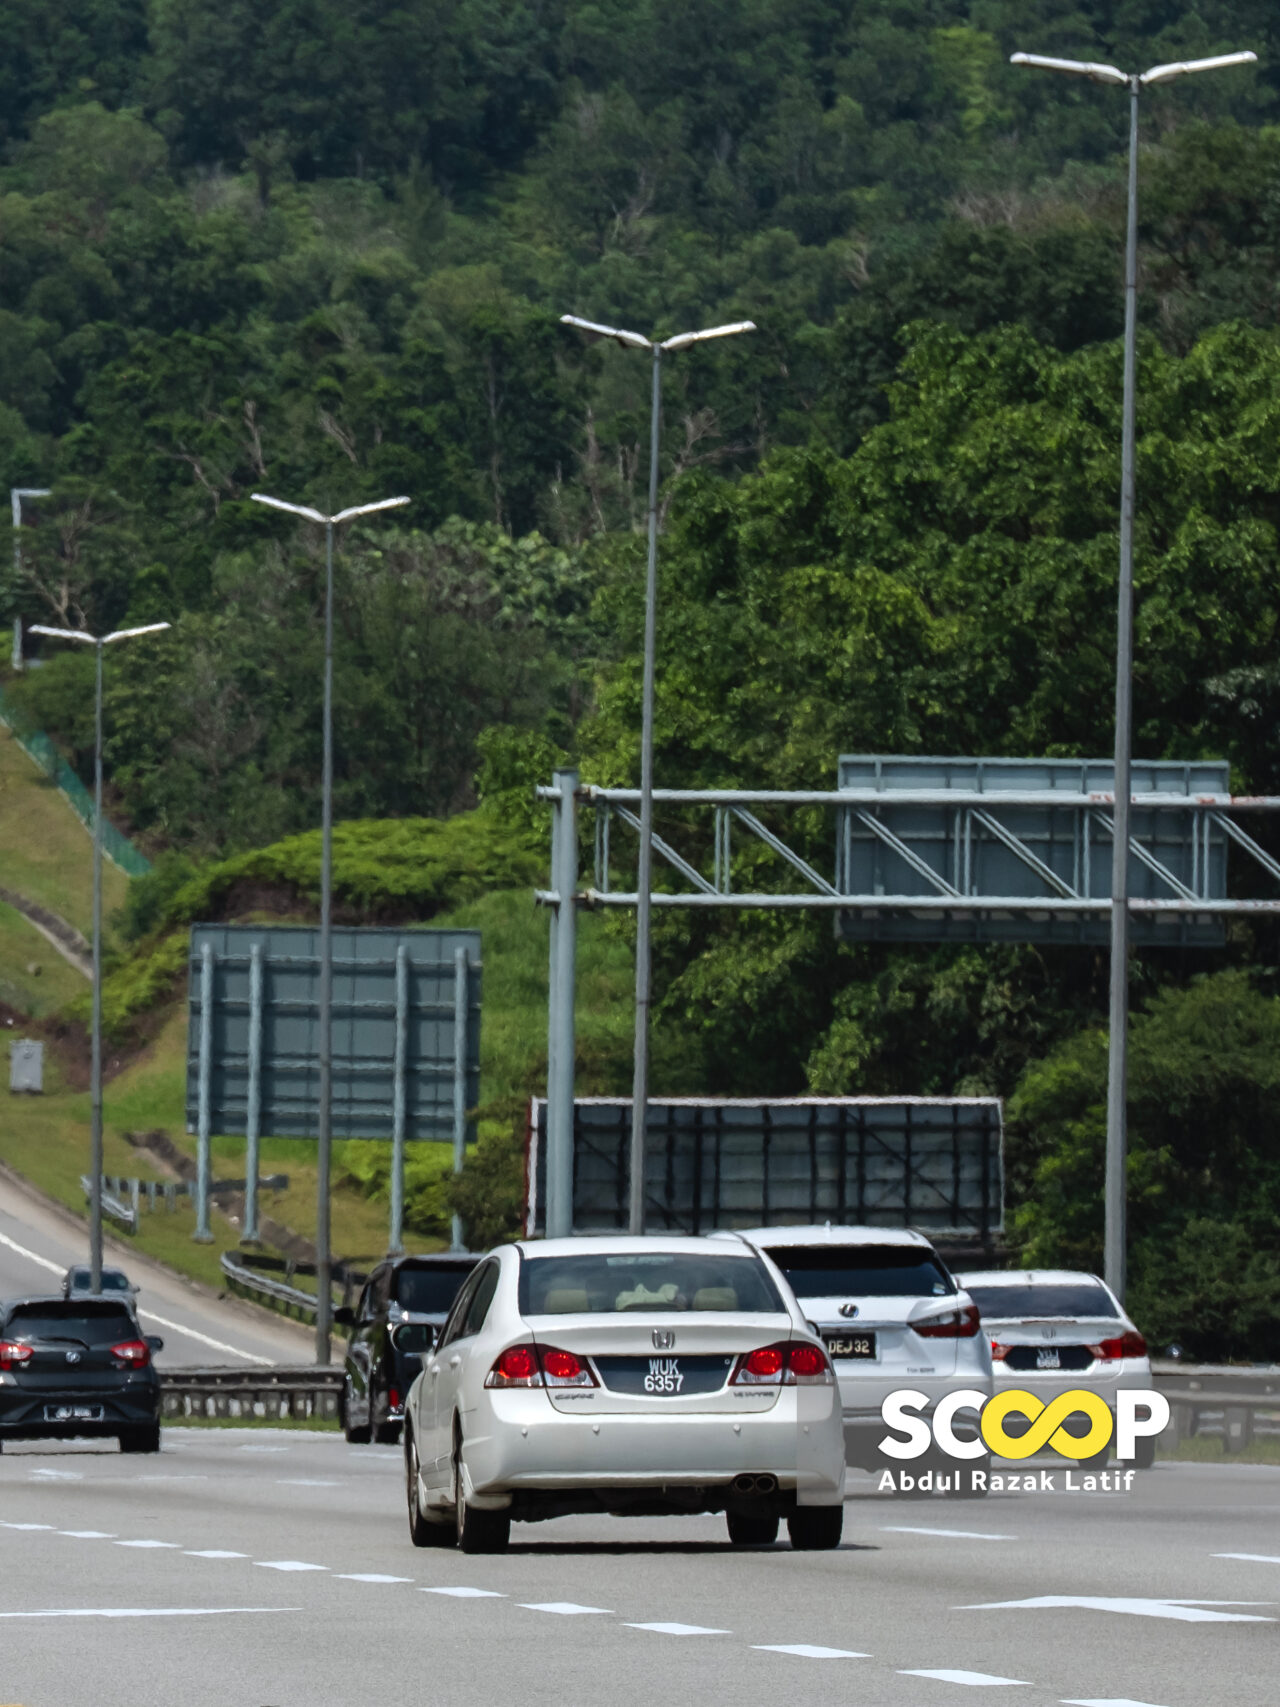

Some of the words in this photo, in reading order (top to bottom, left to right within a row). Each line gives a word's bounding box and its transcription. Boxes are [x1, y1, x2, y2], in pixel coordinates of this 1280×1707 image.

[828, 1340, 853, 1354] DEJ
[854, 1340, 870, 1353] 32
[649, 1358, 679, 1375] WUK
[644, 1374, 684, 1392] 6357
